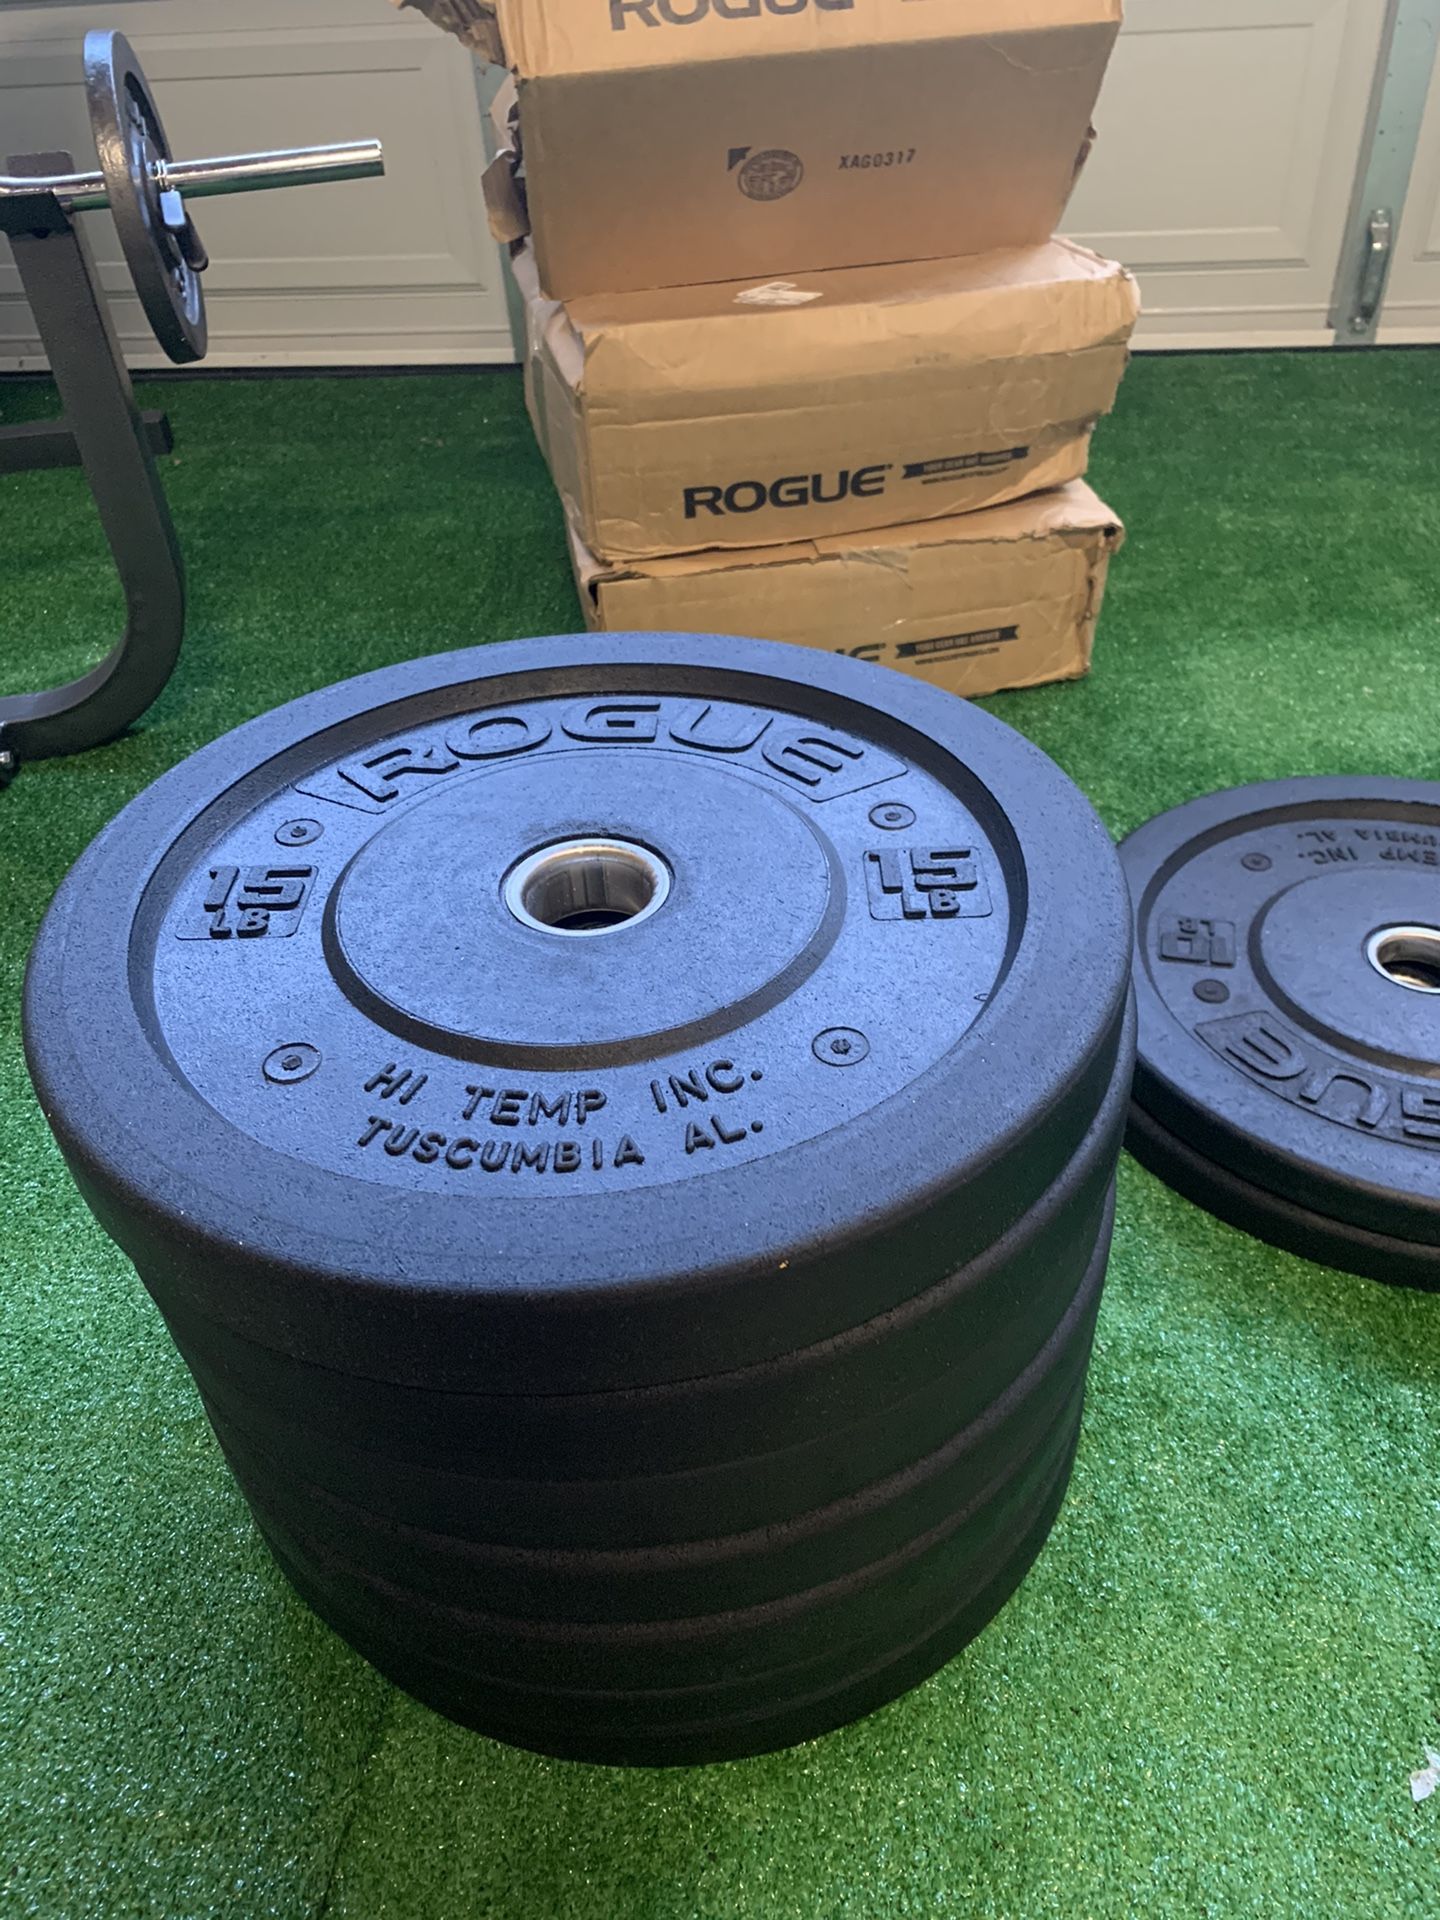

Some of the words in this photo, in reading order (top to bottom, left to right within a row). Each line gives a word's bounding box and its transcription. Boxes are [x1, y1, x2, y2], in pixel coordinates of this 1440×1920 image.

[838, 149, 916, 170] XAG0317
[683, 465, 886, 519] ROGUE
[337, 702, 864, 802] ROGUE
[203, 864, 313, 912] 15
[868, 847, 979, 894] 15
[210, 908, 272, 939] LB
[903, 888, 961, 920] LB
[364, 1062, 428, 1103] HI
[462, 1085, 608, 1127] TEMP
[650, 1059, 763, 1114] INC.
[356, 1115, 644, 1174] TUSCUMBIA
[684, 1116, 763, 1155] AL.
